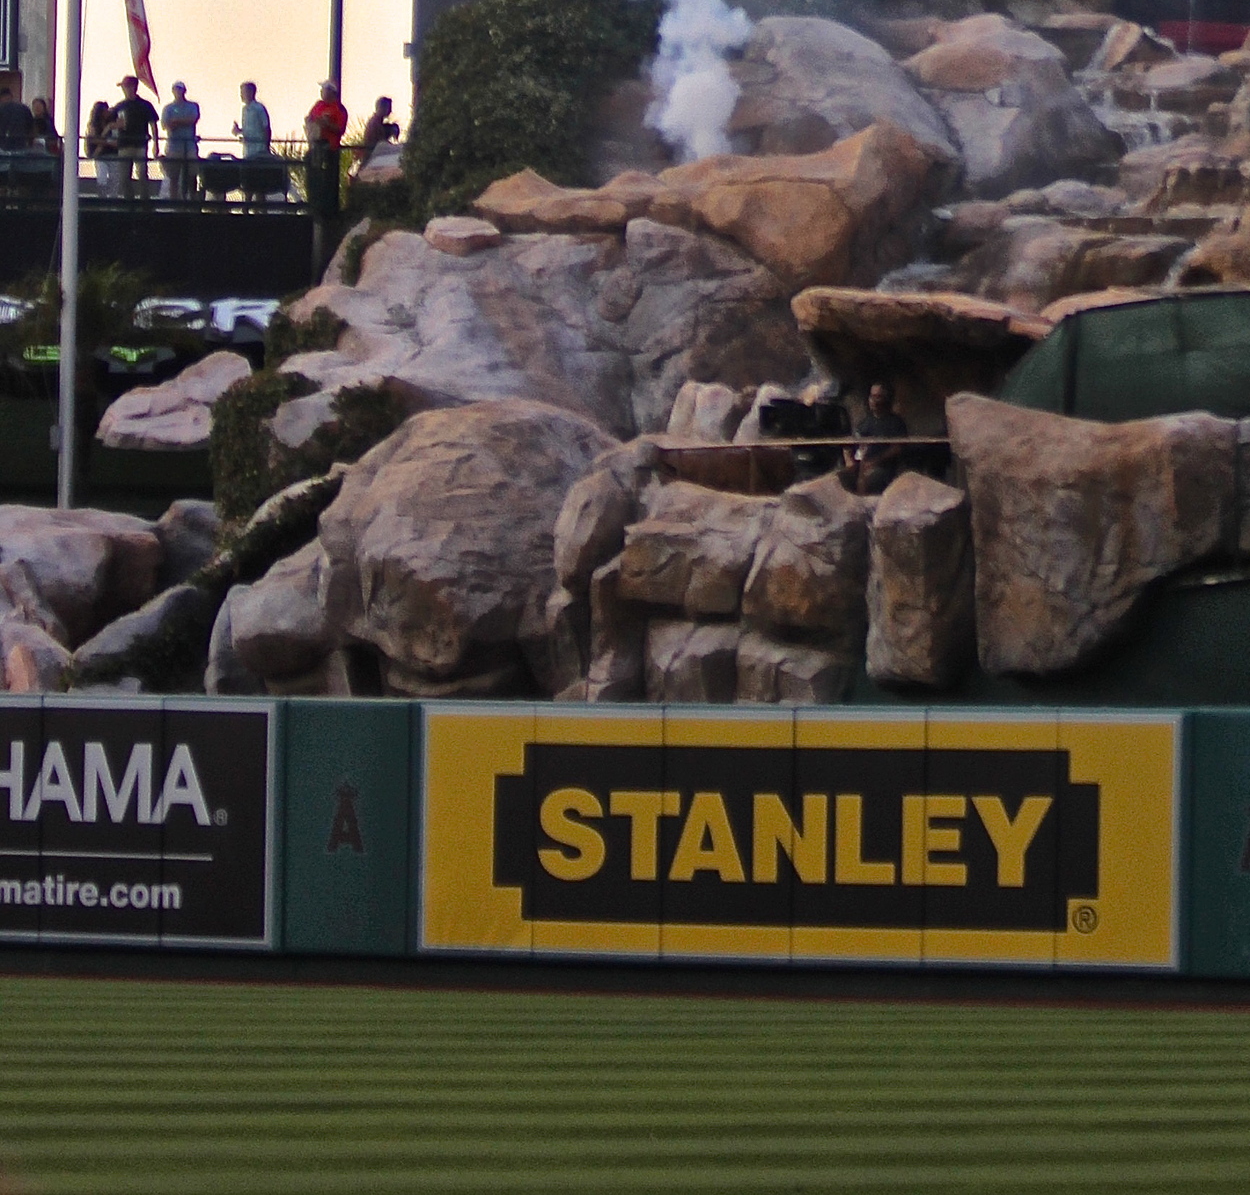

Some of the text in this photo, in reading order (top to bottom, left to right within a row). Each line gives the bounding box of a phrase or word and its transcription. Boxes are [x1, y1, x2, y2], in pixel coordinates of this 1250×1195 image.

[326, 781, 365, 854] A
[537, 787, 1054, 888] STANLEY
[0, 874, 182, 910] matire.com
